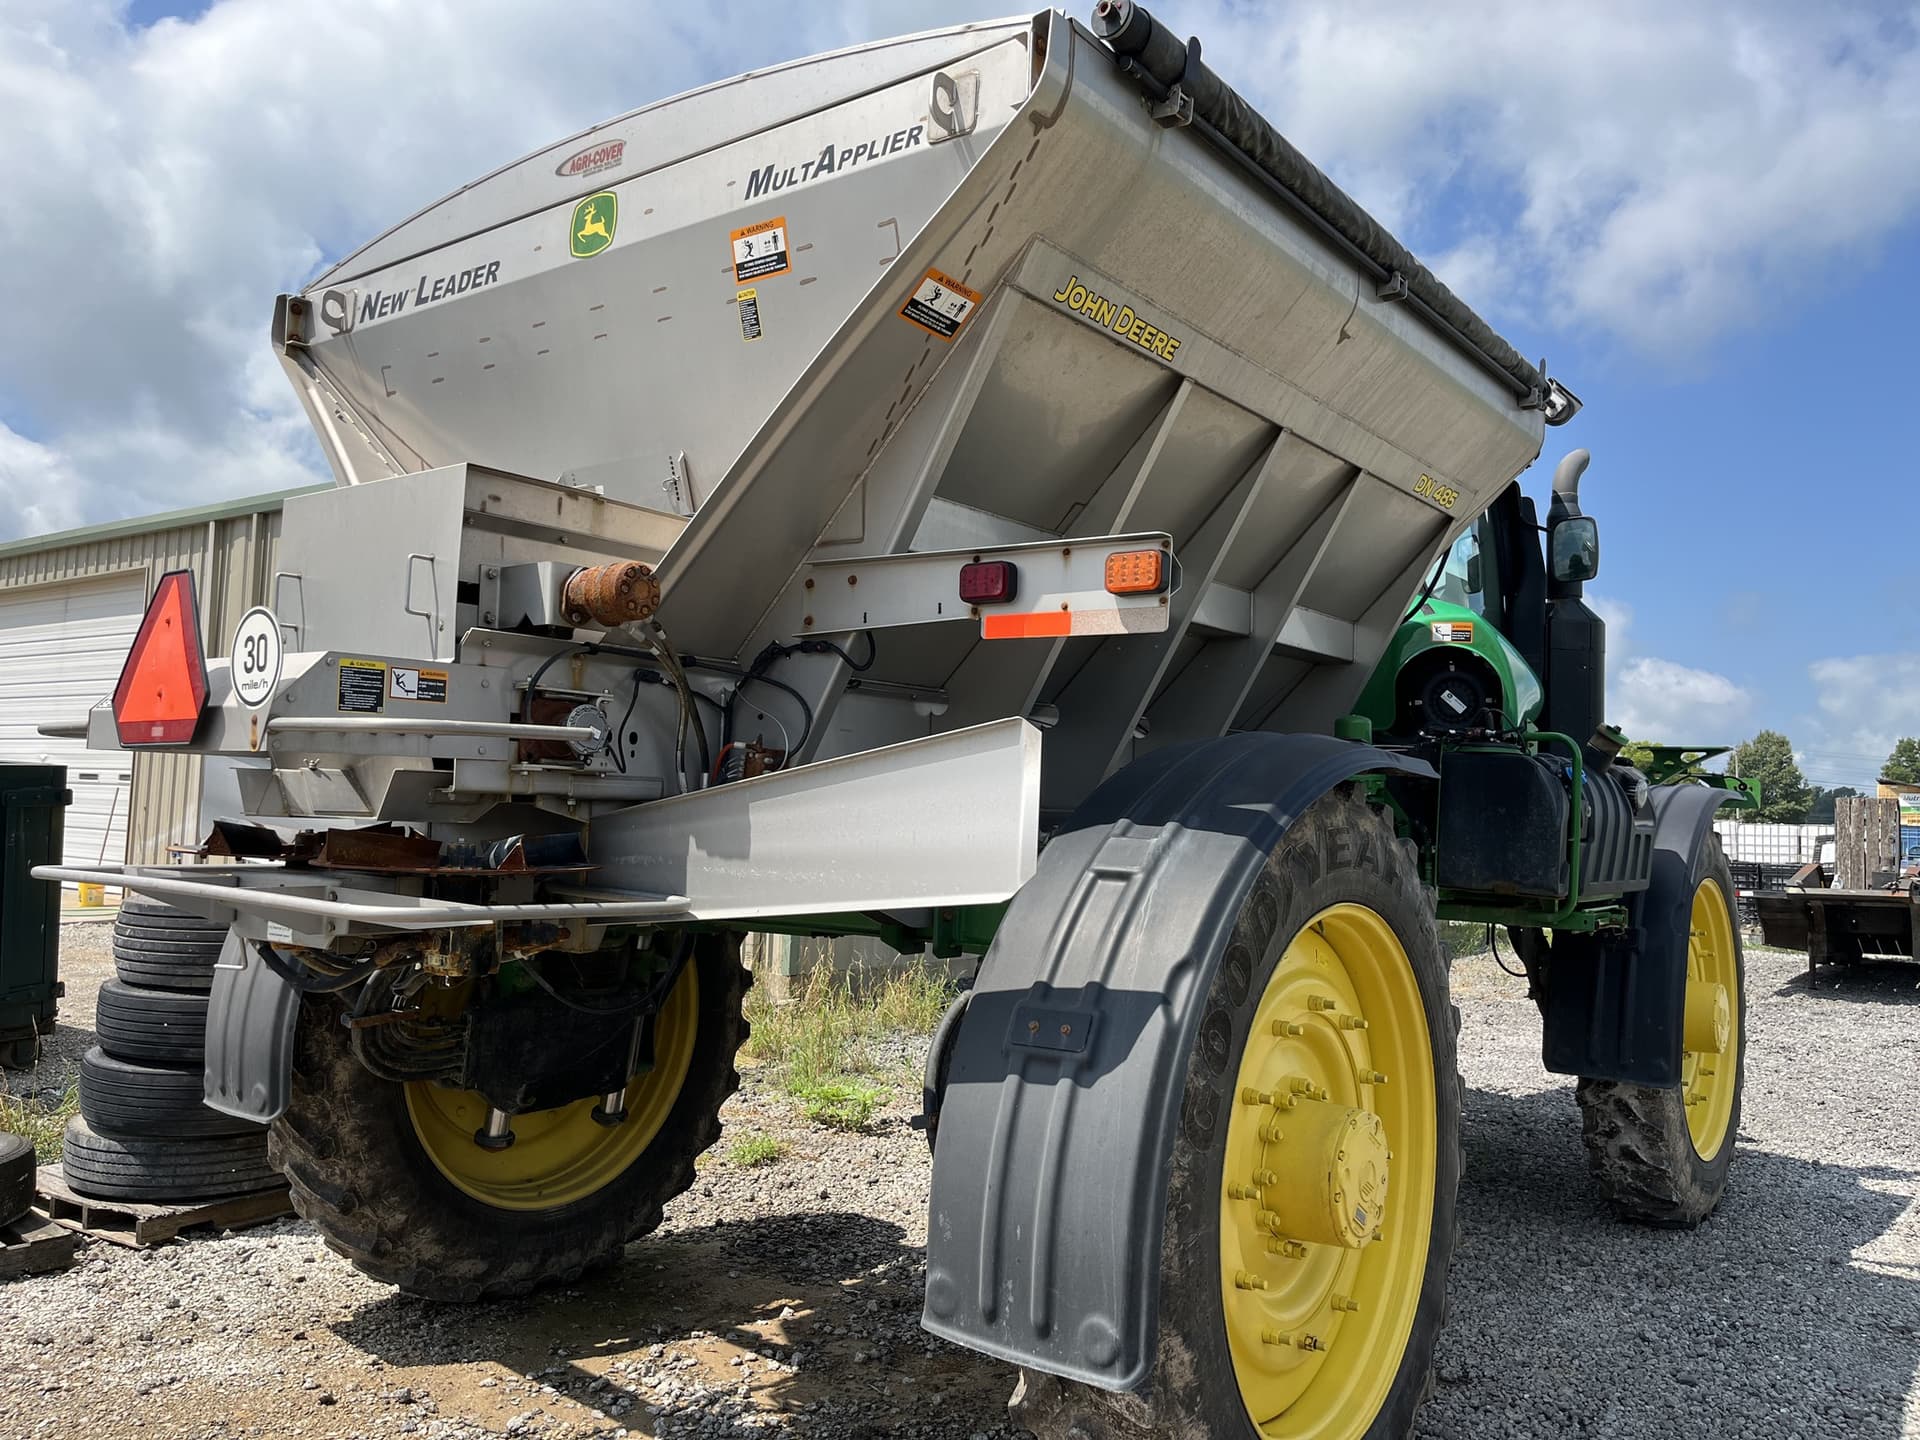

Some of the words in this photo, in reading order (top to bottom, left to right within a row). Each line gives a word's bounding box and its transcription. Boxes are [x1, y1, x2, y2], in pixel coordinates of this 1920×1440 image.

[569, 142, 624, 173] AGRI-COVER
[744, 125, 924, 200] MULTAPPLIER
[746, 220, 775, 235] WARNING
[359, 289, 409, 323] NEW
[414, 260, 501, 307] LEADER
[945, 279, 974, 298] WARNING
[1053, 275, 1118, 328] JOHN
[1112, 305, 1182, 363] DEERE
[1413, 473, 1437, 498] DN
[1432, 484, 1460, 509] 485
[244, 633, 268, 674] 30
[241, 678, 269, 691] mile/h
